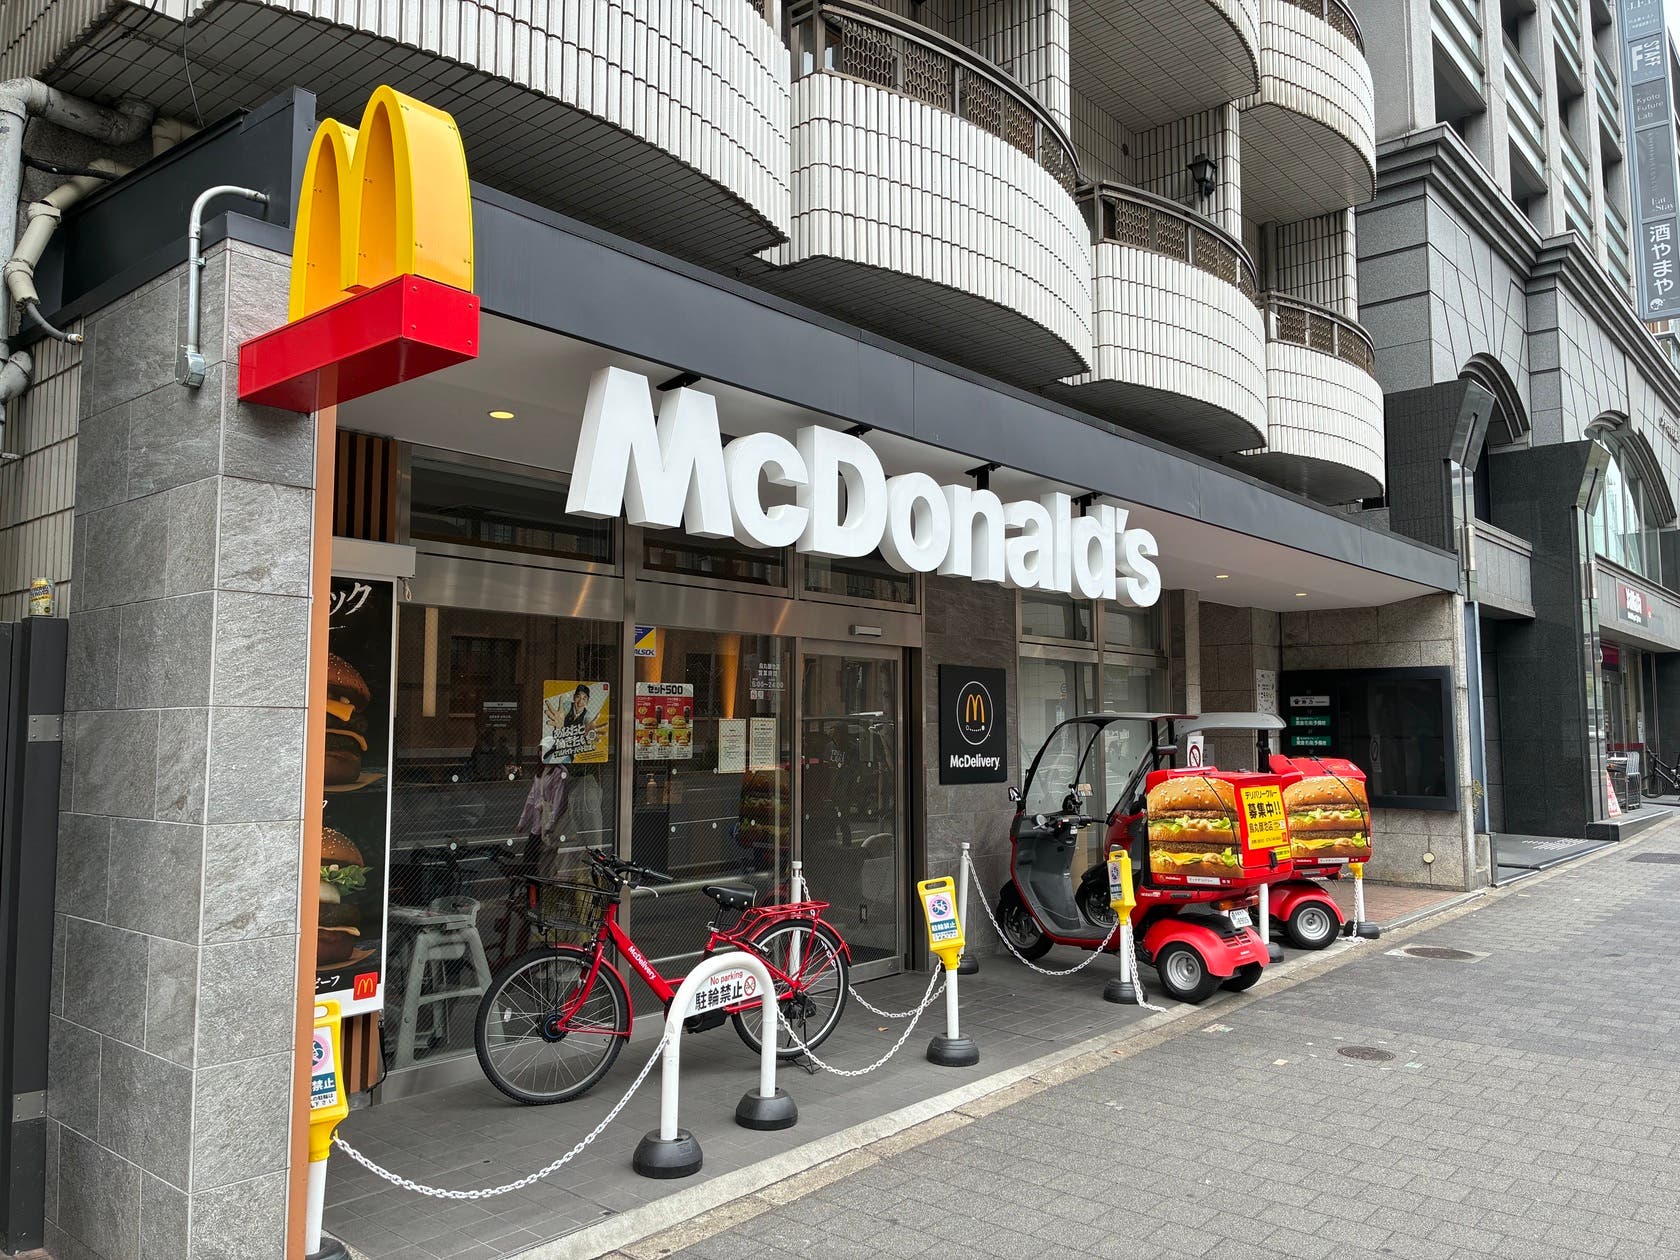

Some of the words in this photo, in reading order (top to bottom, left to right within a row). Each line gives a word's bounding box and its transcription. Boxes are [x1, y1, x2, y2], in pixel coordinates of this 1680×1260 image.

[1643, 40, 1661, 66] STAFF
[1636, 93, 1661, 105] Kyoto
[1637, 101, 1664, 113] Future
[1637, 112, 1654, 121] Lab
[1649, 223, 1674, 296] 酒やまや
[565, 366, 1161, 607] McDonald's
[647, 684, 684, 695] セット500
[949, 753, 1001, 771] McDelivery
[627, 945, 657, 981] McDelivery
[710, 976, 720, 986] No
[720, 971, 744, 984] parking
[695, 981, 743, 1011] 駐輪禁止
